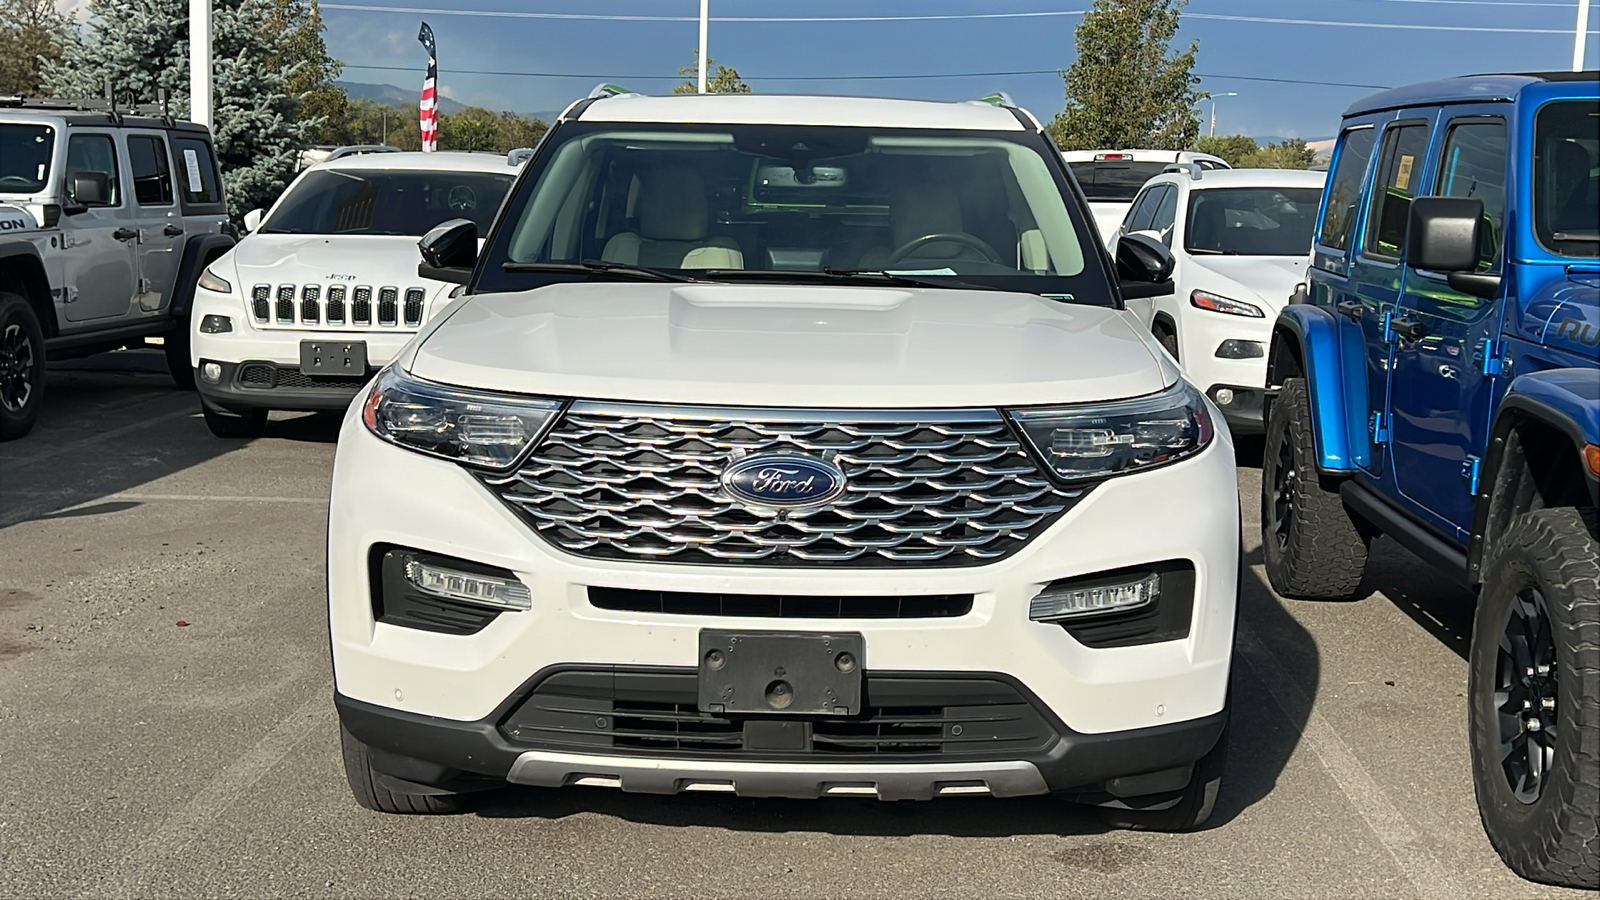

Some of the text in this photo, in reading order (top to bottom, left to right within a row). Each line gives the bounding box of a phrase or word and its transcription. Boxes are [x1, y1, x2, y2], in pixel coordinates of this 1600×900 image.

[0, 219, 25, 230] ON
[326, 273, 356, 281] Jeep
[752, 467, 815, 494] Ford
